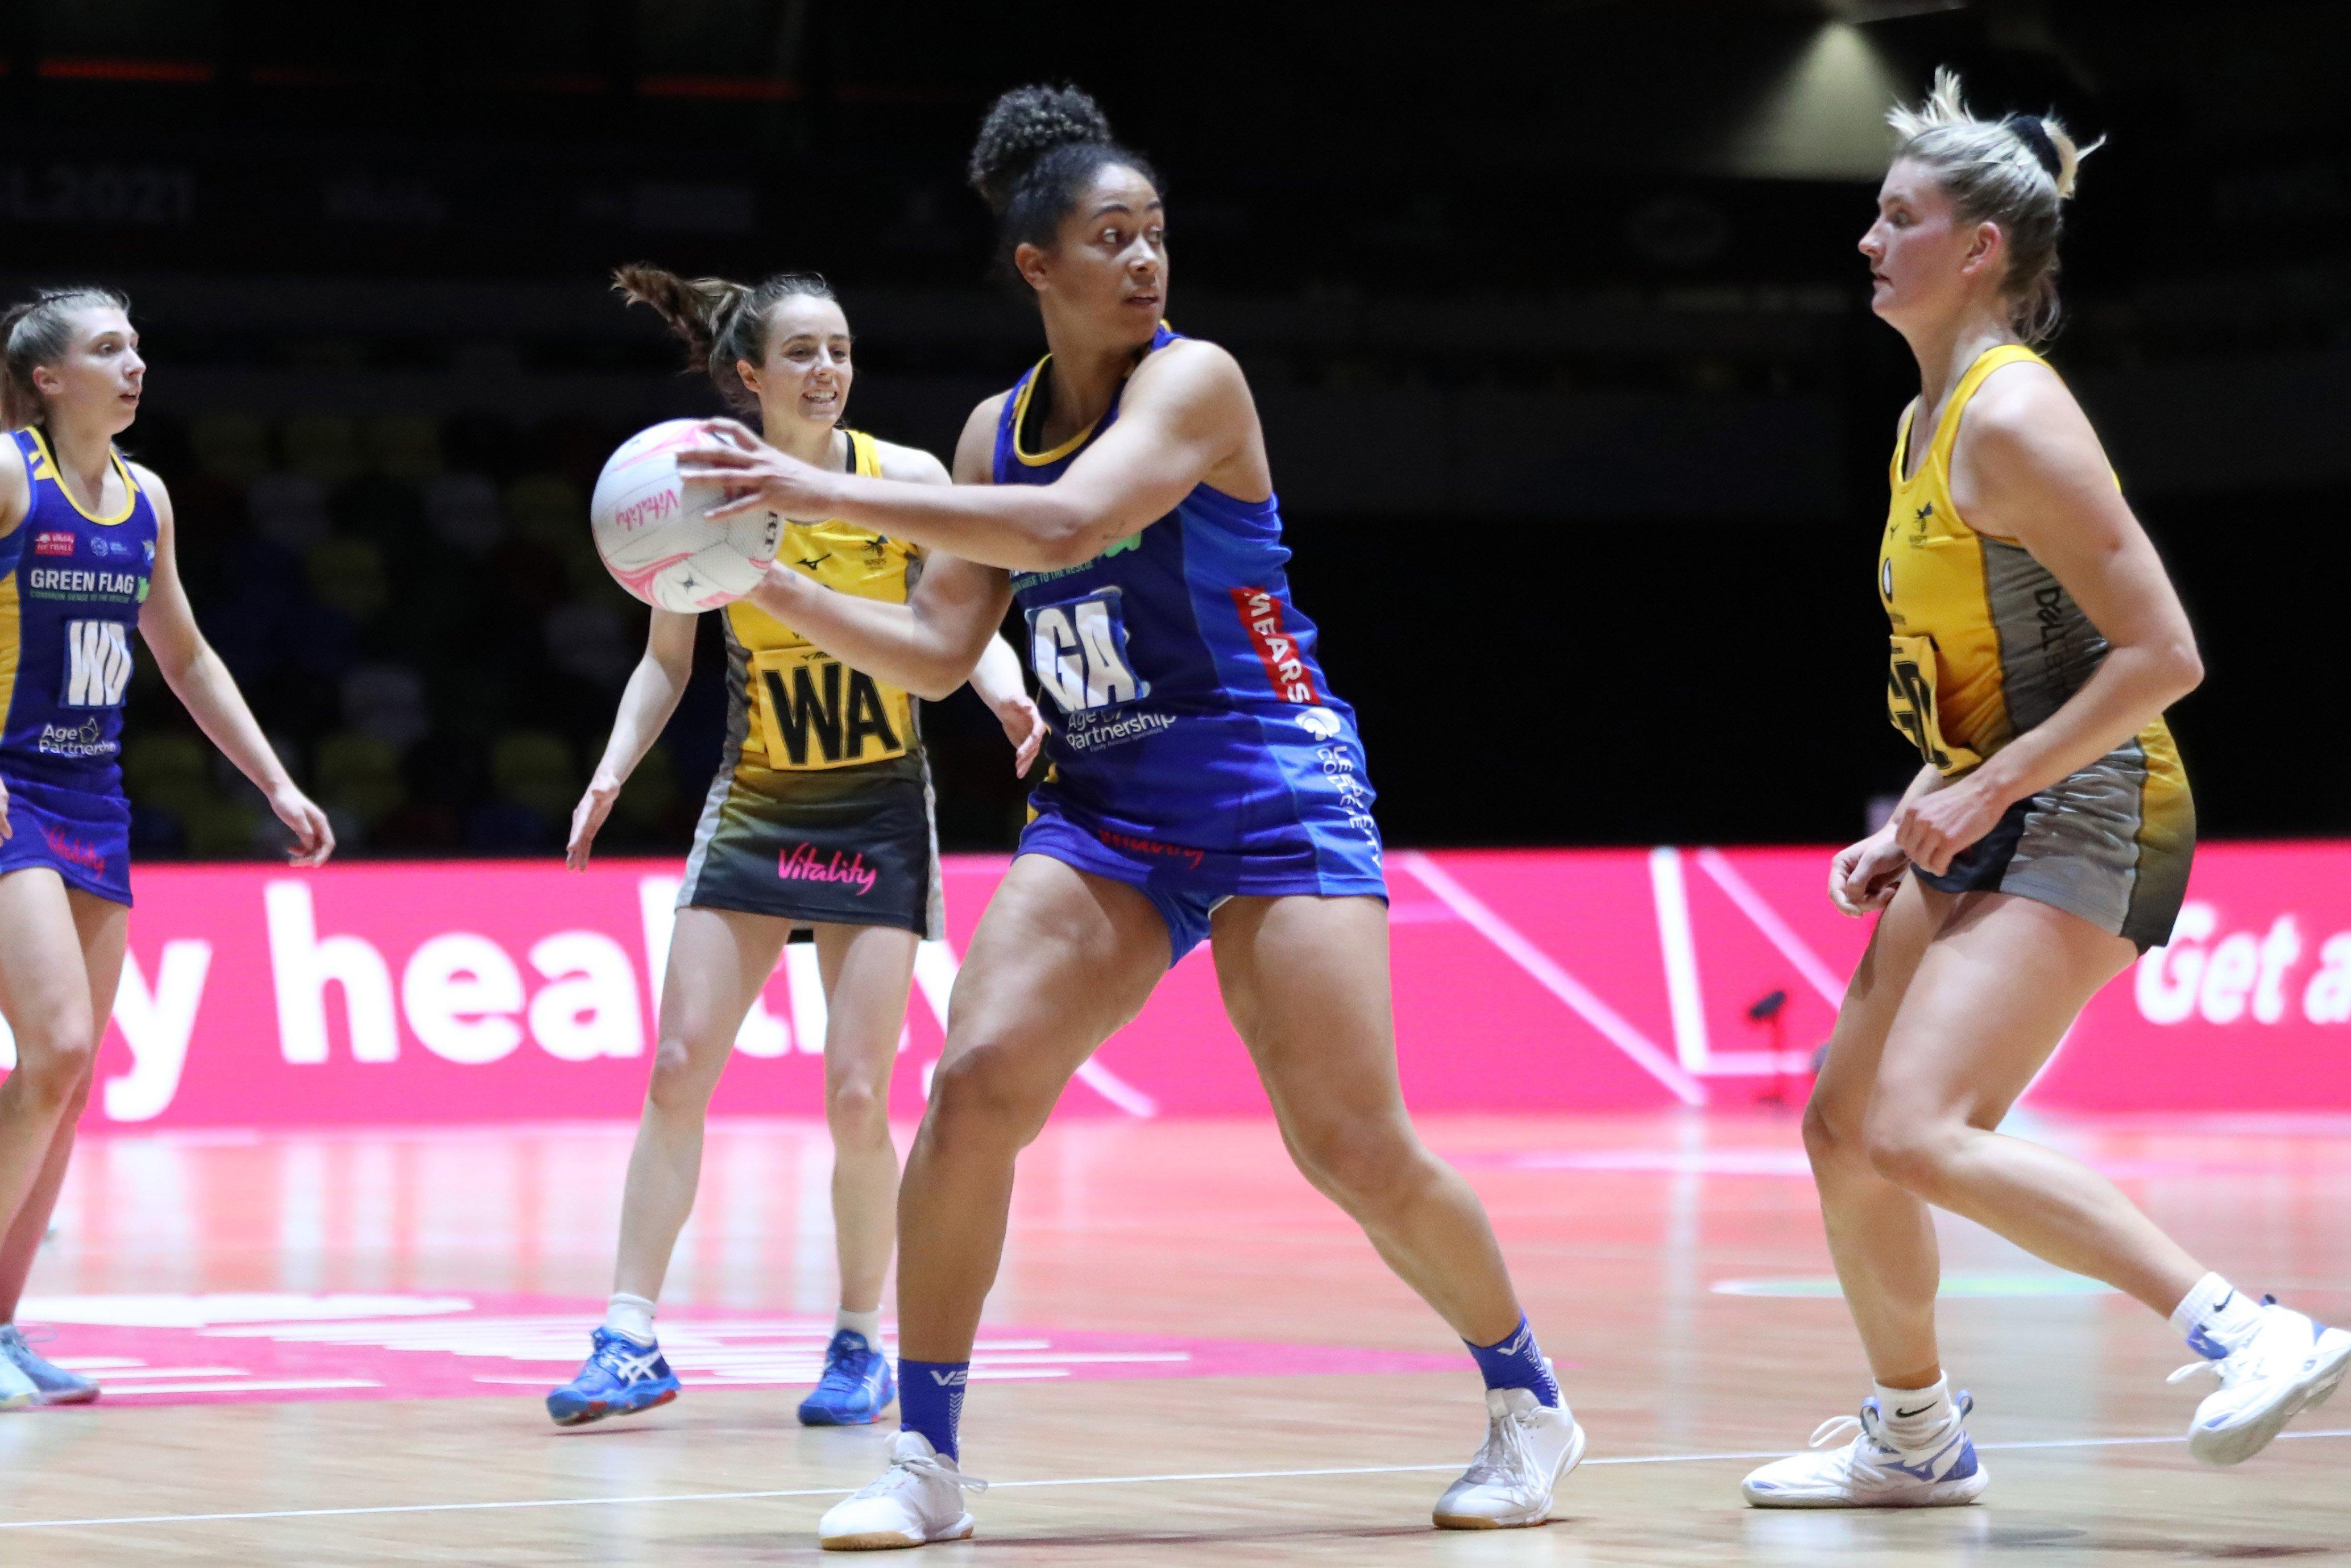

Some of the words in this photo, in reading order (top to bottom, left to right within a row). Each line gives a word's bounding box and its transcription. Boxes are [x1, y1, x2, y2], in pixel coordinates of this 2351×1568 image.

[616, 489, 678, 531] Vitality
[31, 569, 96, 592] GREEN
[98, 572, 135, 595] FLAG
[1035, 600, 1136, 712] GA
[1243, 592, 1312, 704] MEARS
[41, 723, 78, 742] Age
[761, 661, 905, 766] WA
[1068, 710, 1097, 731] Age
[778, 841, 878, 896] Vitality
[2135, 900, 2299, 1024] Get
